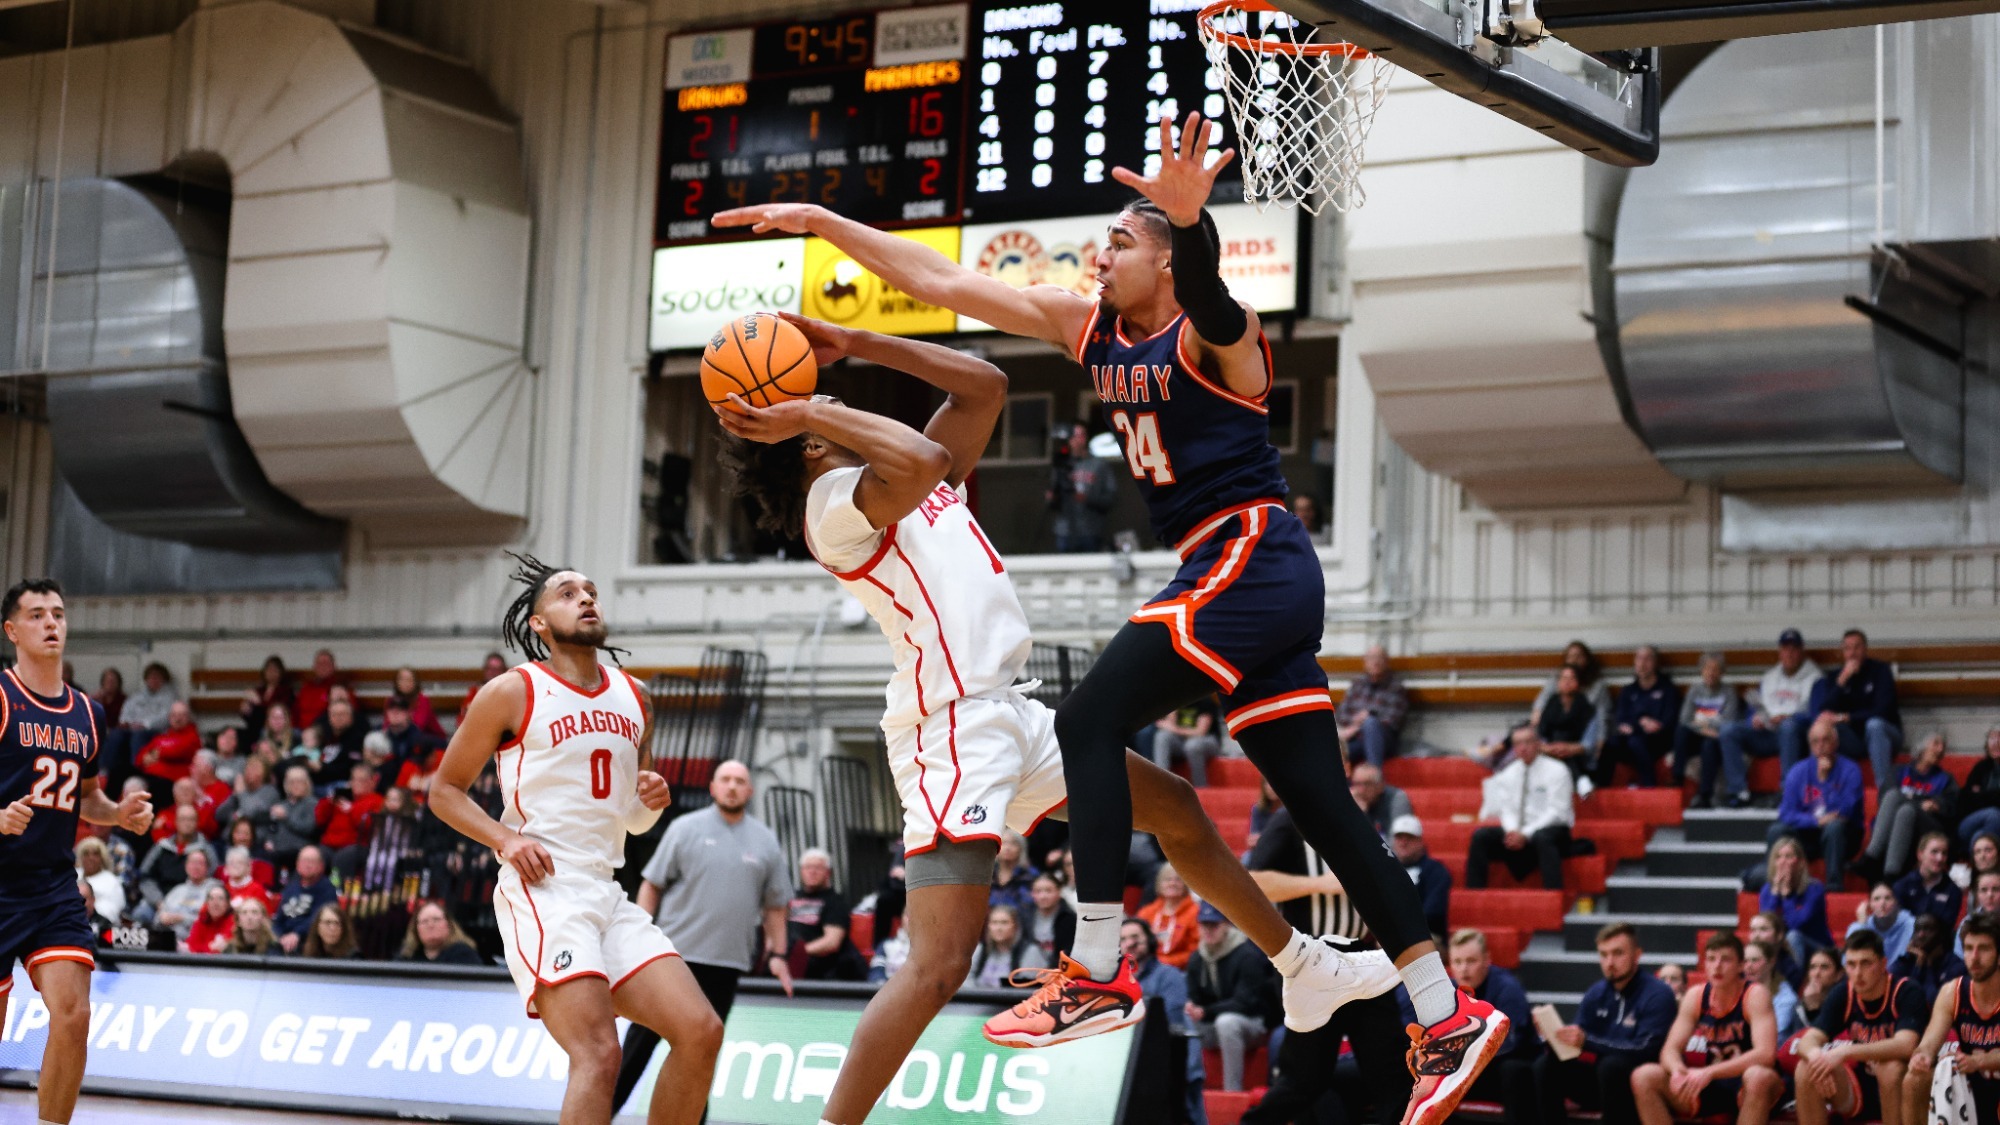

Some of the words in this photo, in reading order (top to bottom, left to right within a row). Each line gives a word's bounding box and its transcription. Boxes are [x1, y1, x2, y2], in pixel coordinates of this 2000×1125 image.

[785, 19, 868, 64] 9:45
[983, 36, 1019, 60] No.
[1029, 27, 1078, 55] Foul
[1148, 45, 1163, 69] 1
[981, 61, 1001, 86] 0
[1037, 56, 1057, 80] 0
[1088, 50, 1109, 75] 7
[1147, 72, 1169, 95] 4
[909, 91, 945, 136] 16
[980, 88, 995, 112] 1
[1035, 82, 1056, 107] 0
[689, 115, 738, 159] 21
[810, 110, 820, 141] 1
[979, 114, 1000, 138] 4
[1034, 109, 1055, 134] 0
[1084, 104, 1106, 129] 4
[977, 141, 1004, 165] 11
[1033, 136, 1054, 161] 0
[1085, 131, 1106, 156] 0
[919, 158, 941, 195] 2
[976, 167, 1007, 192] 12
[1032, 163, 1052, 188] 0
[1084, 159, 1105, 183] 2
[684, 179, 704, 215] 2
[658, 280, 796, 315] sodexo
[1111, 409, 1177, 486] 24
[18, 722, 89, 759] UMARY
[549, 709, 640, 749] DRAGONS
[30, 755, 81, 813] 22
[590, 748, 612, 800] 0
[111, 926, 149, 946] POSS
[180, 1008, 249, 1059] TO
[259, 1013, 371, 1066] GET
[367, 1020, 569, 1082] AROUN
